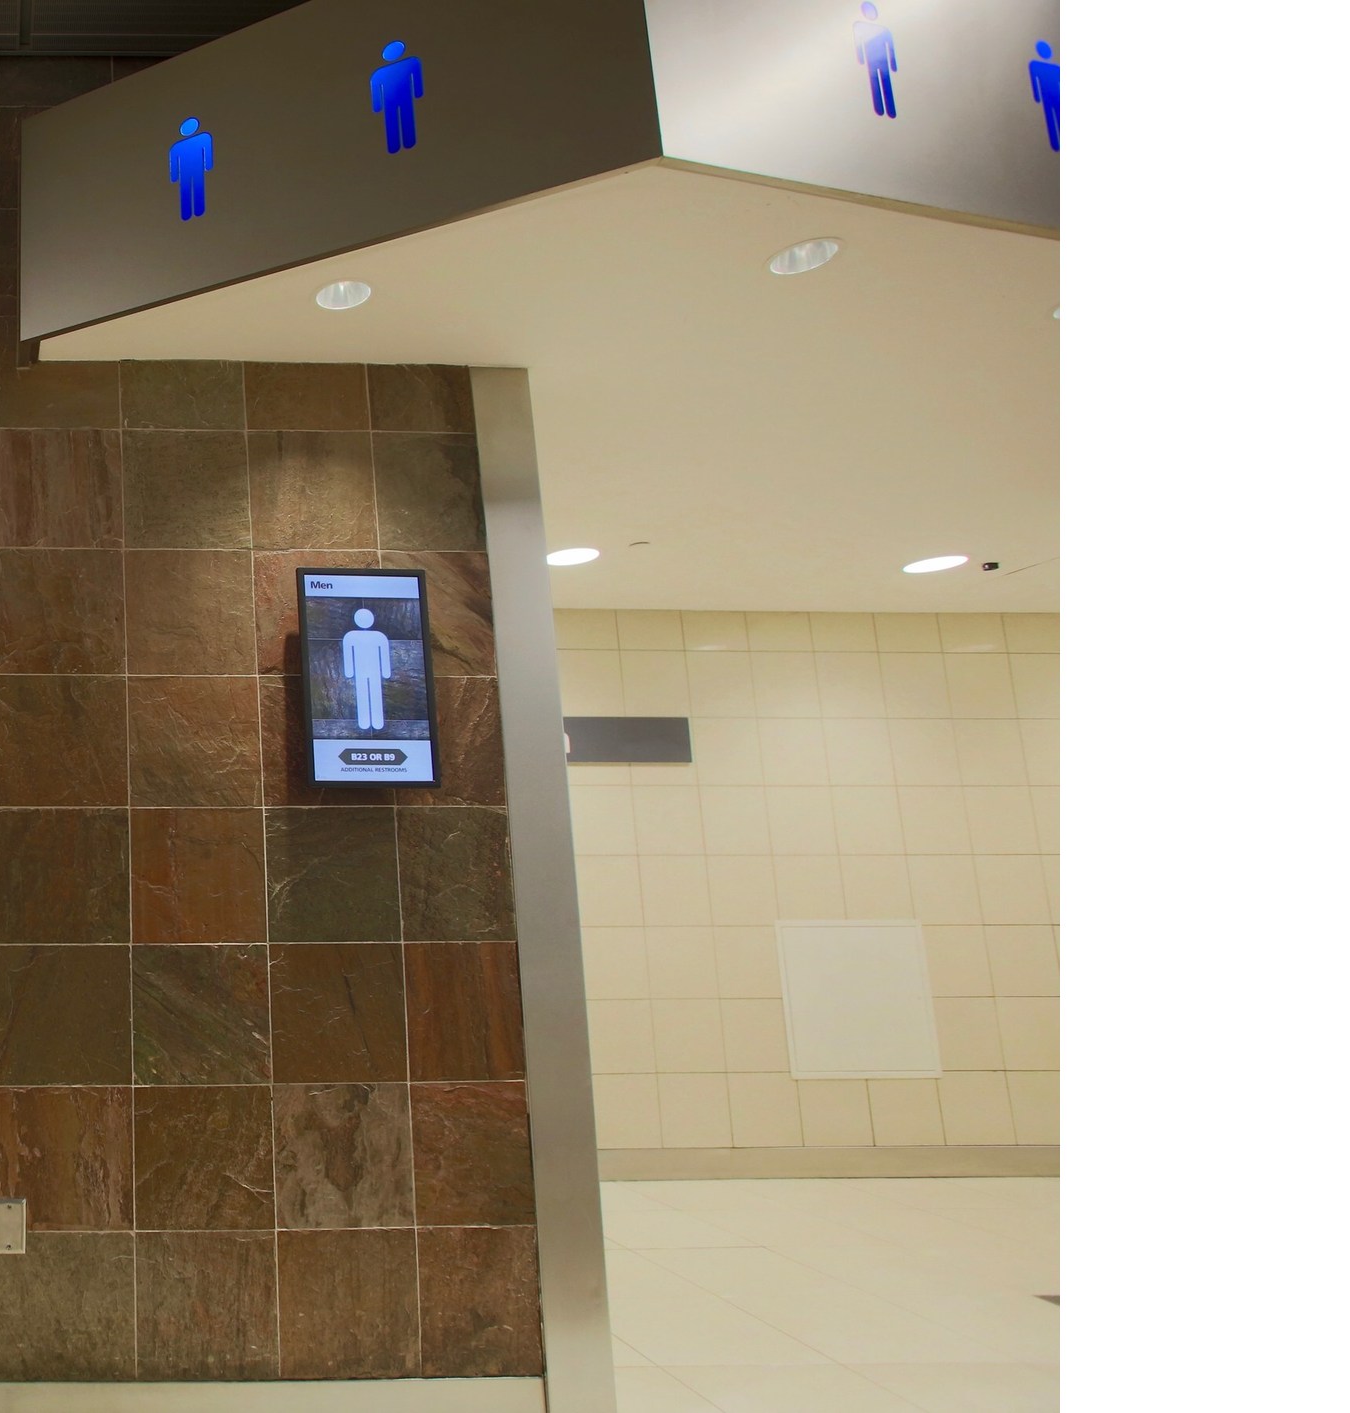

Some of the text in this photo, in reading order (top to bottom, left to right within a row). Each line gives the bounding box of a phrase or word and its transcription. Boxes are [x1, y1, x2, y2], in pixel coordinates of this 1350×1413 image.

[310, 581, 333, 590] Men
[351, 753, 396, 762] B23 OR B9
